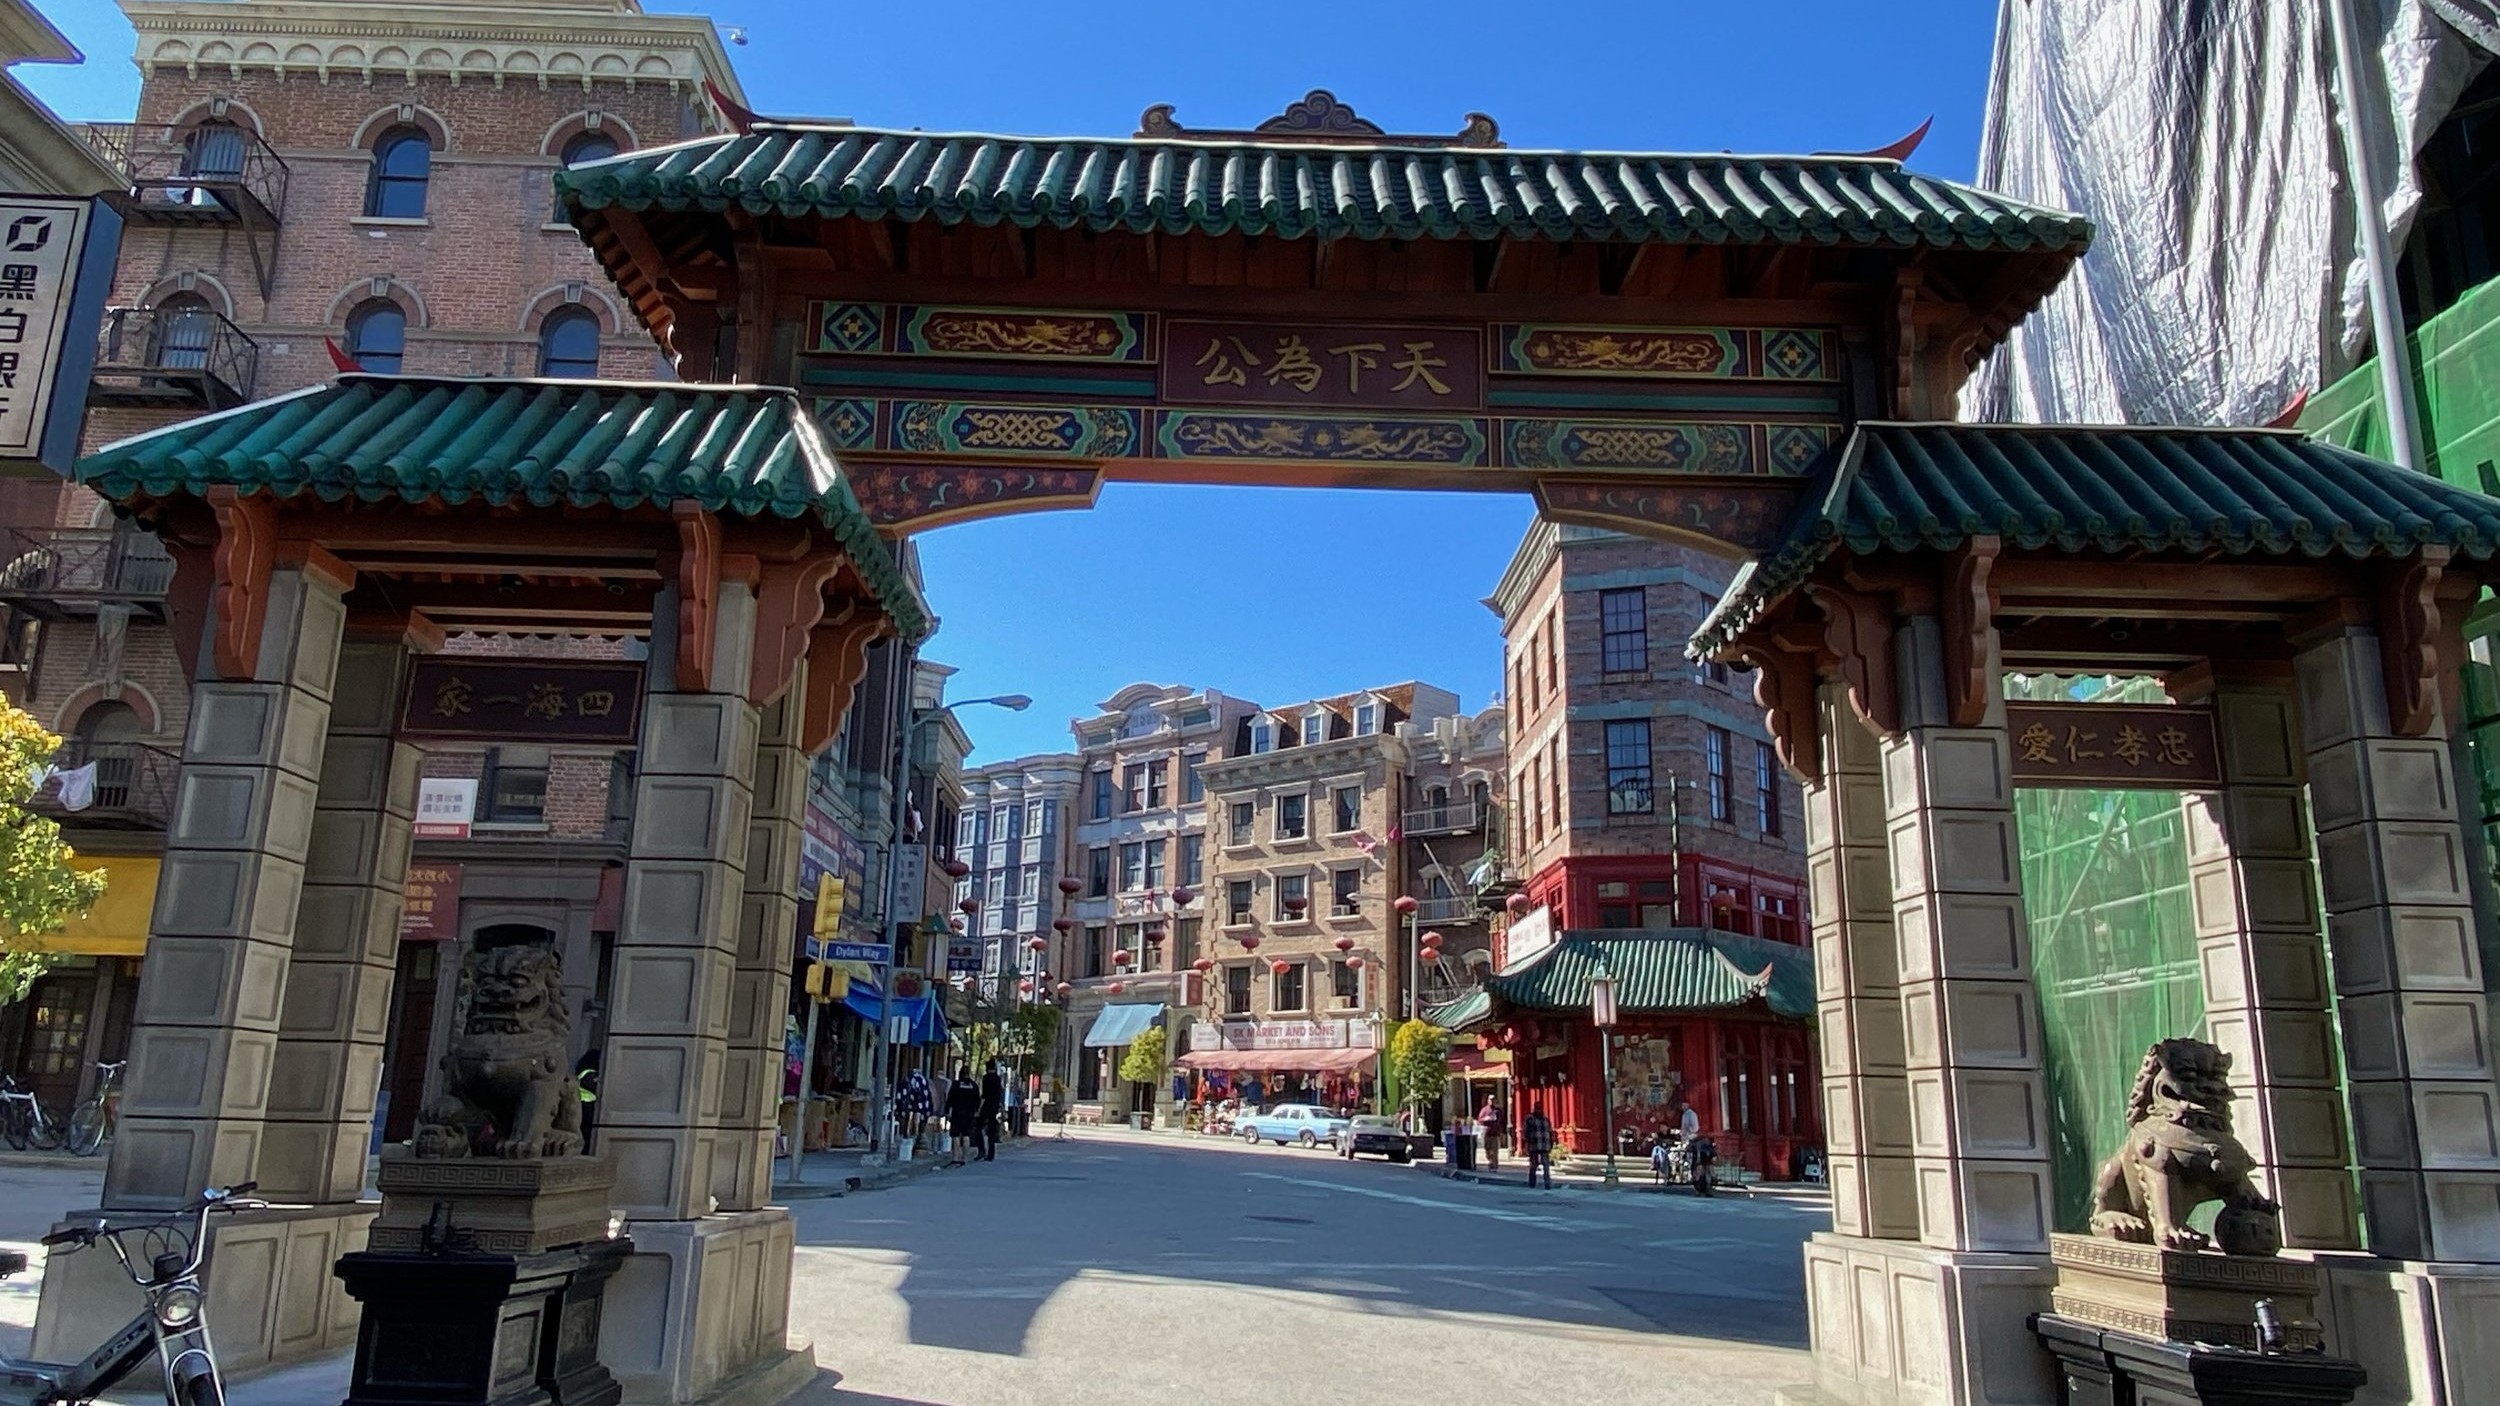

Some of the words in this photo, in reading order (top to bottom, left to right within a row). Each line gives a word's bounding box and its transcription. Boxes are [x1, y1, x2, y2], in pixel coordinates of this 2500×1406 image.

[835, 946, 860, 957] Dylan
[862, 947, 880, 960] Way
[1247, 1026, 1282, 1038] MARKET
[1285, 1026, 1306, 1037] AND
[1309, 1024, 1335, 1036] SONS
